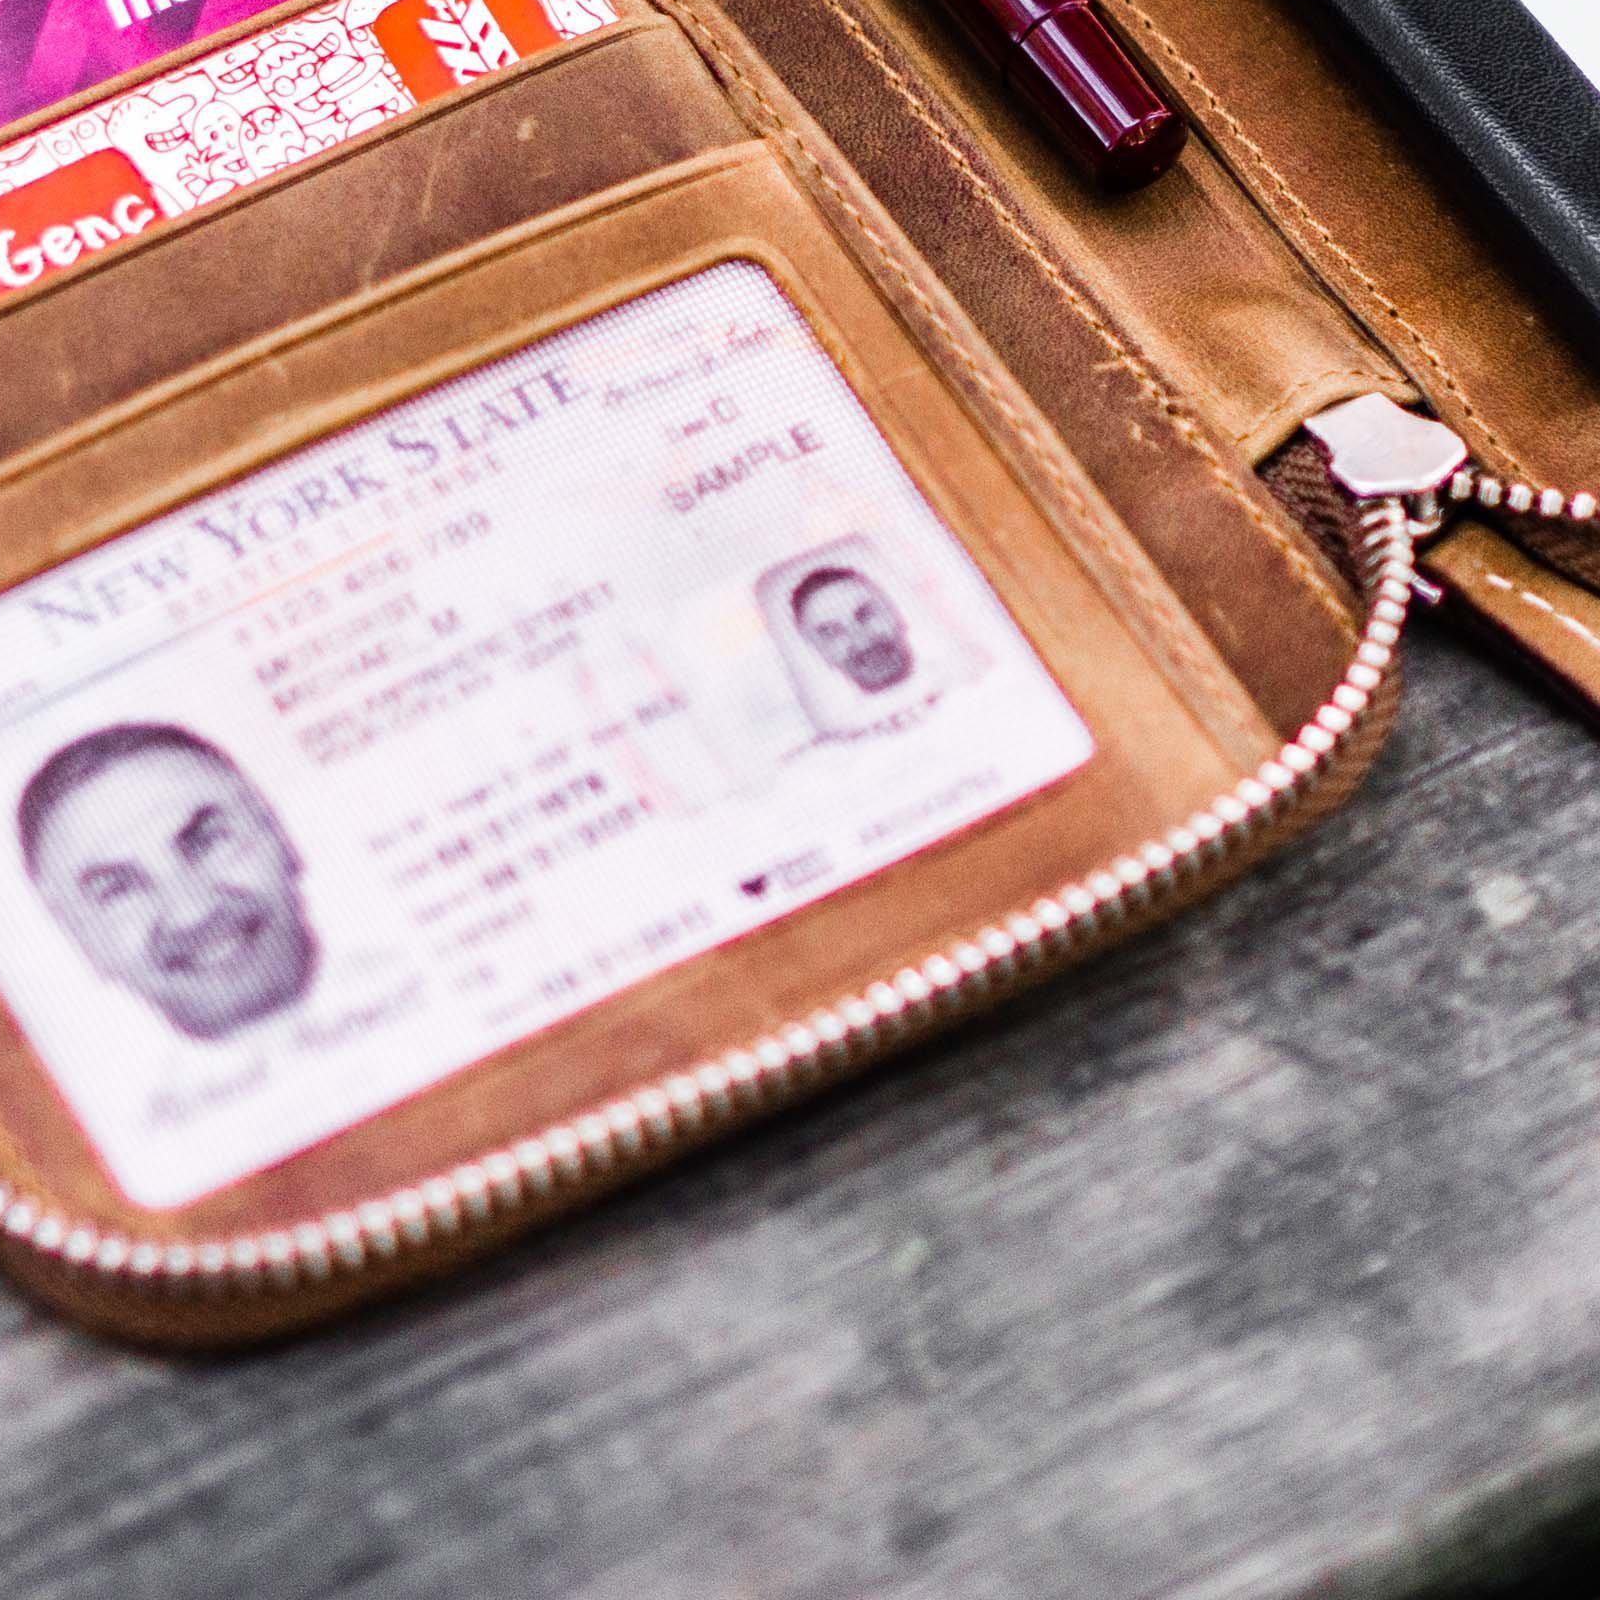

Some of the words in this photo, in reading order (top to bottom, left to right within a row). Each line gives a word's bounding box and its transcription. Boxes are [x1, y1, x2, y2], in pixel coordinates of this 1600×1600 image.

[194, 454, 391, 560] YORK
[385, 361, 591, 473] STATE
[663, 418, 826, 516] SAMPLE
